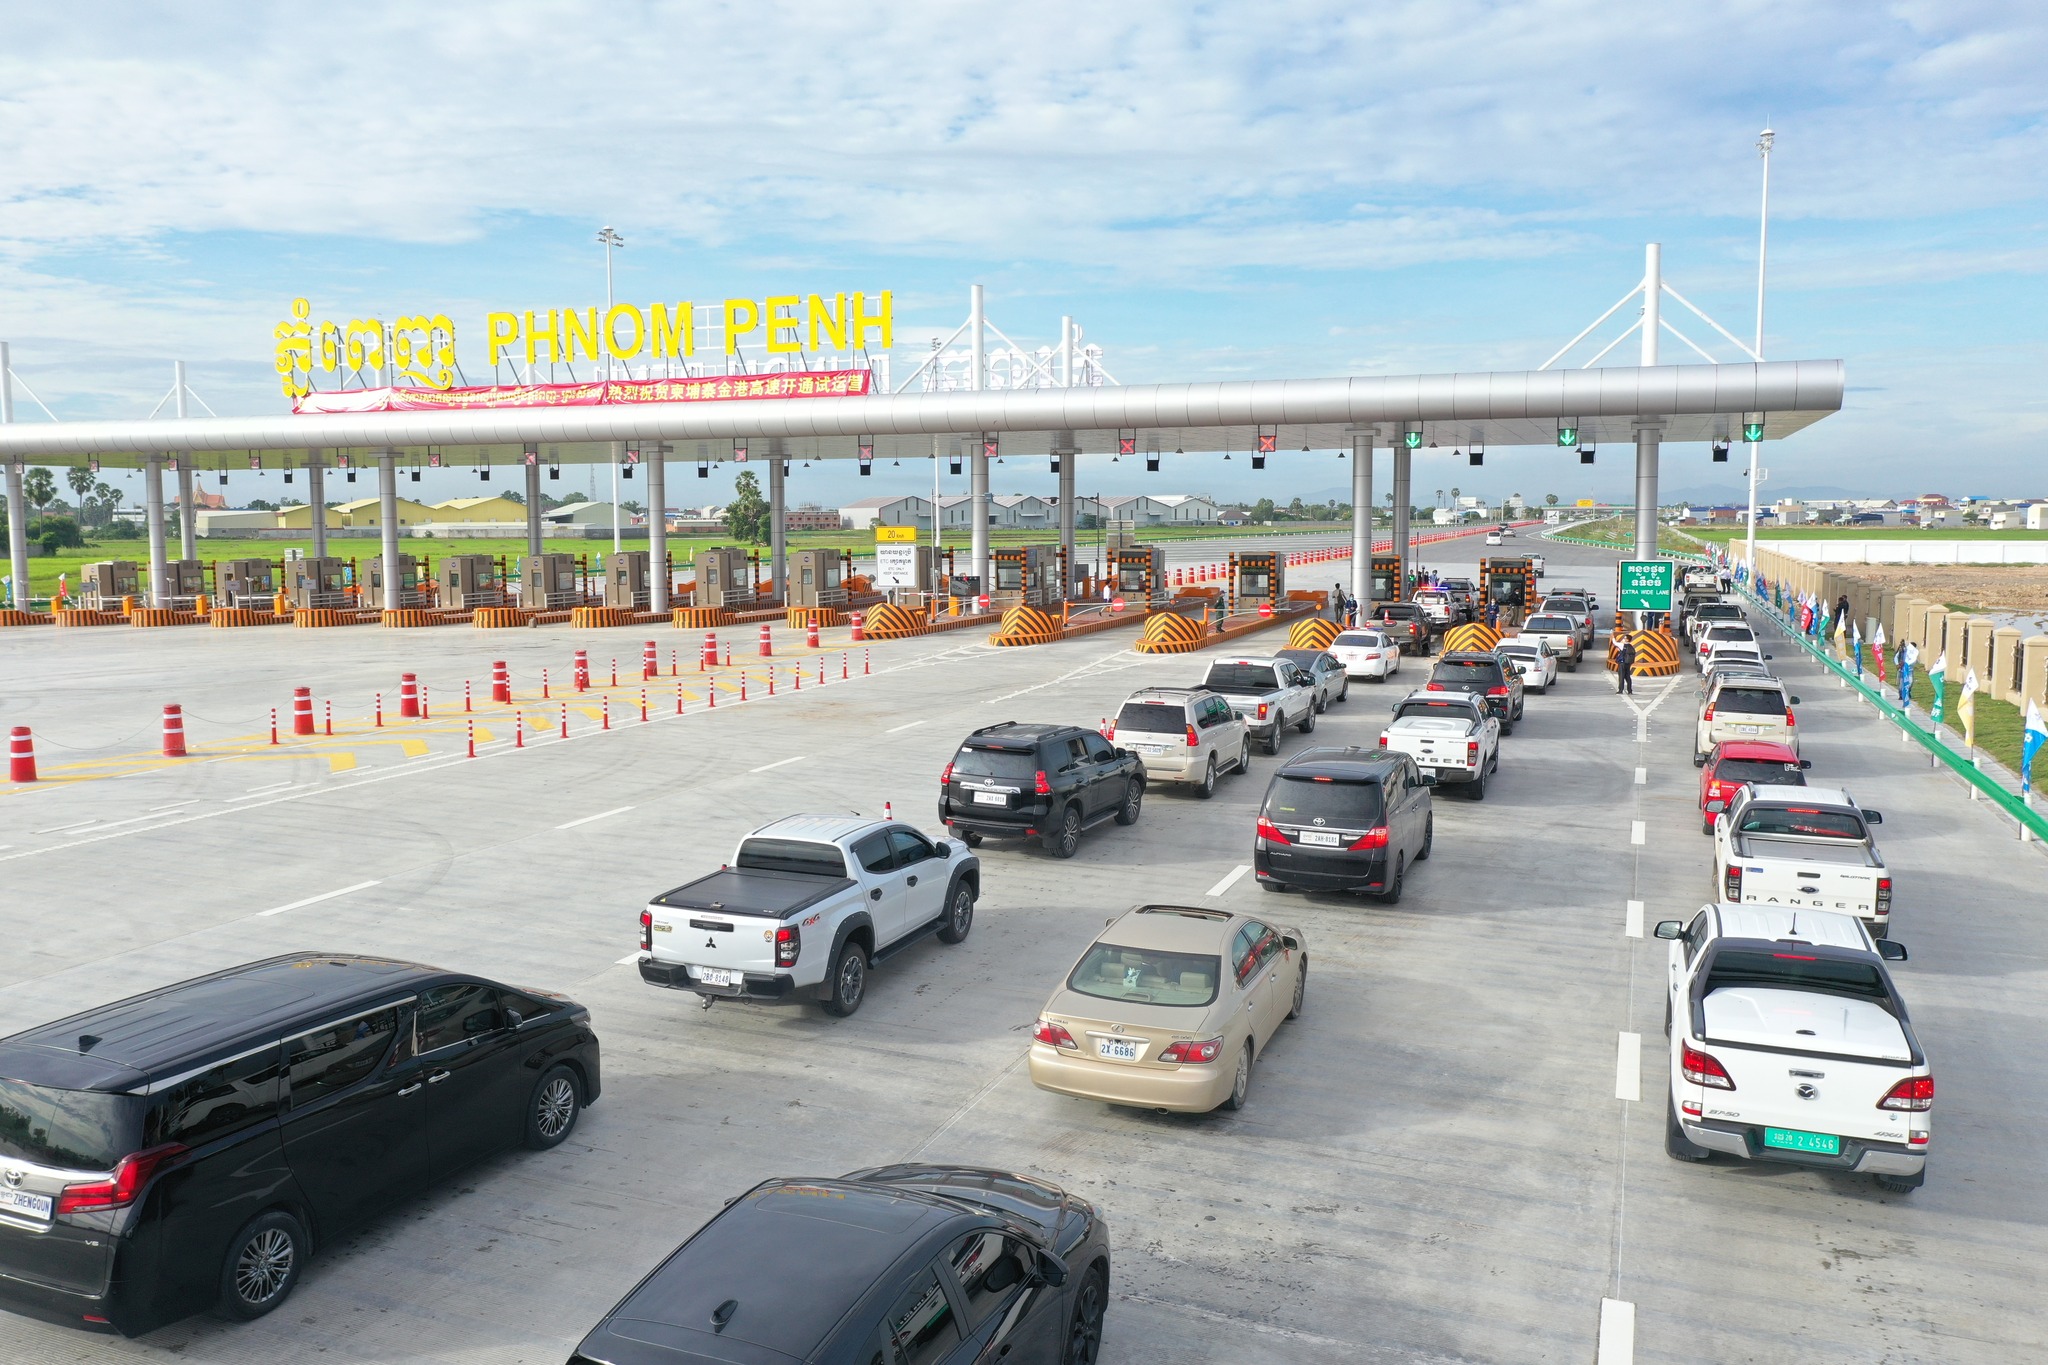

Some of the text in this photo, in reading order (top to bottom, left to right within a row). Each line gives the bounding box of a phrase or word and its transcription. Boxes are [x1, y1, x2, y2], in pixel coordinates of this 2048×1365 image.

[487, 289, 894, 367] PHNOM PENH
[274, 298, 456, 397] ភ្នំពេញ
[606, 374, 865, 402] 热烈祝贺柬埔寨金港高速开通试运营
[887, 530, 896, 538] 20
[1416, 756, 1466, 765] NGER
[1746, 894, 1870, 911] RANGER
[1808, 1137, 1835, 1150] 4546
